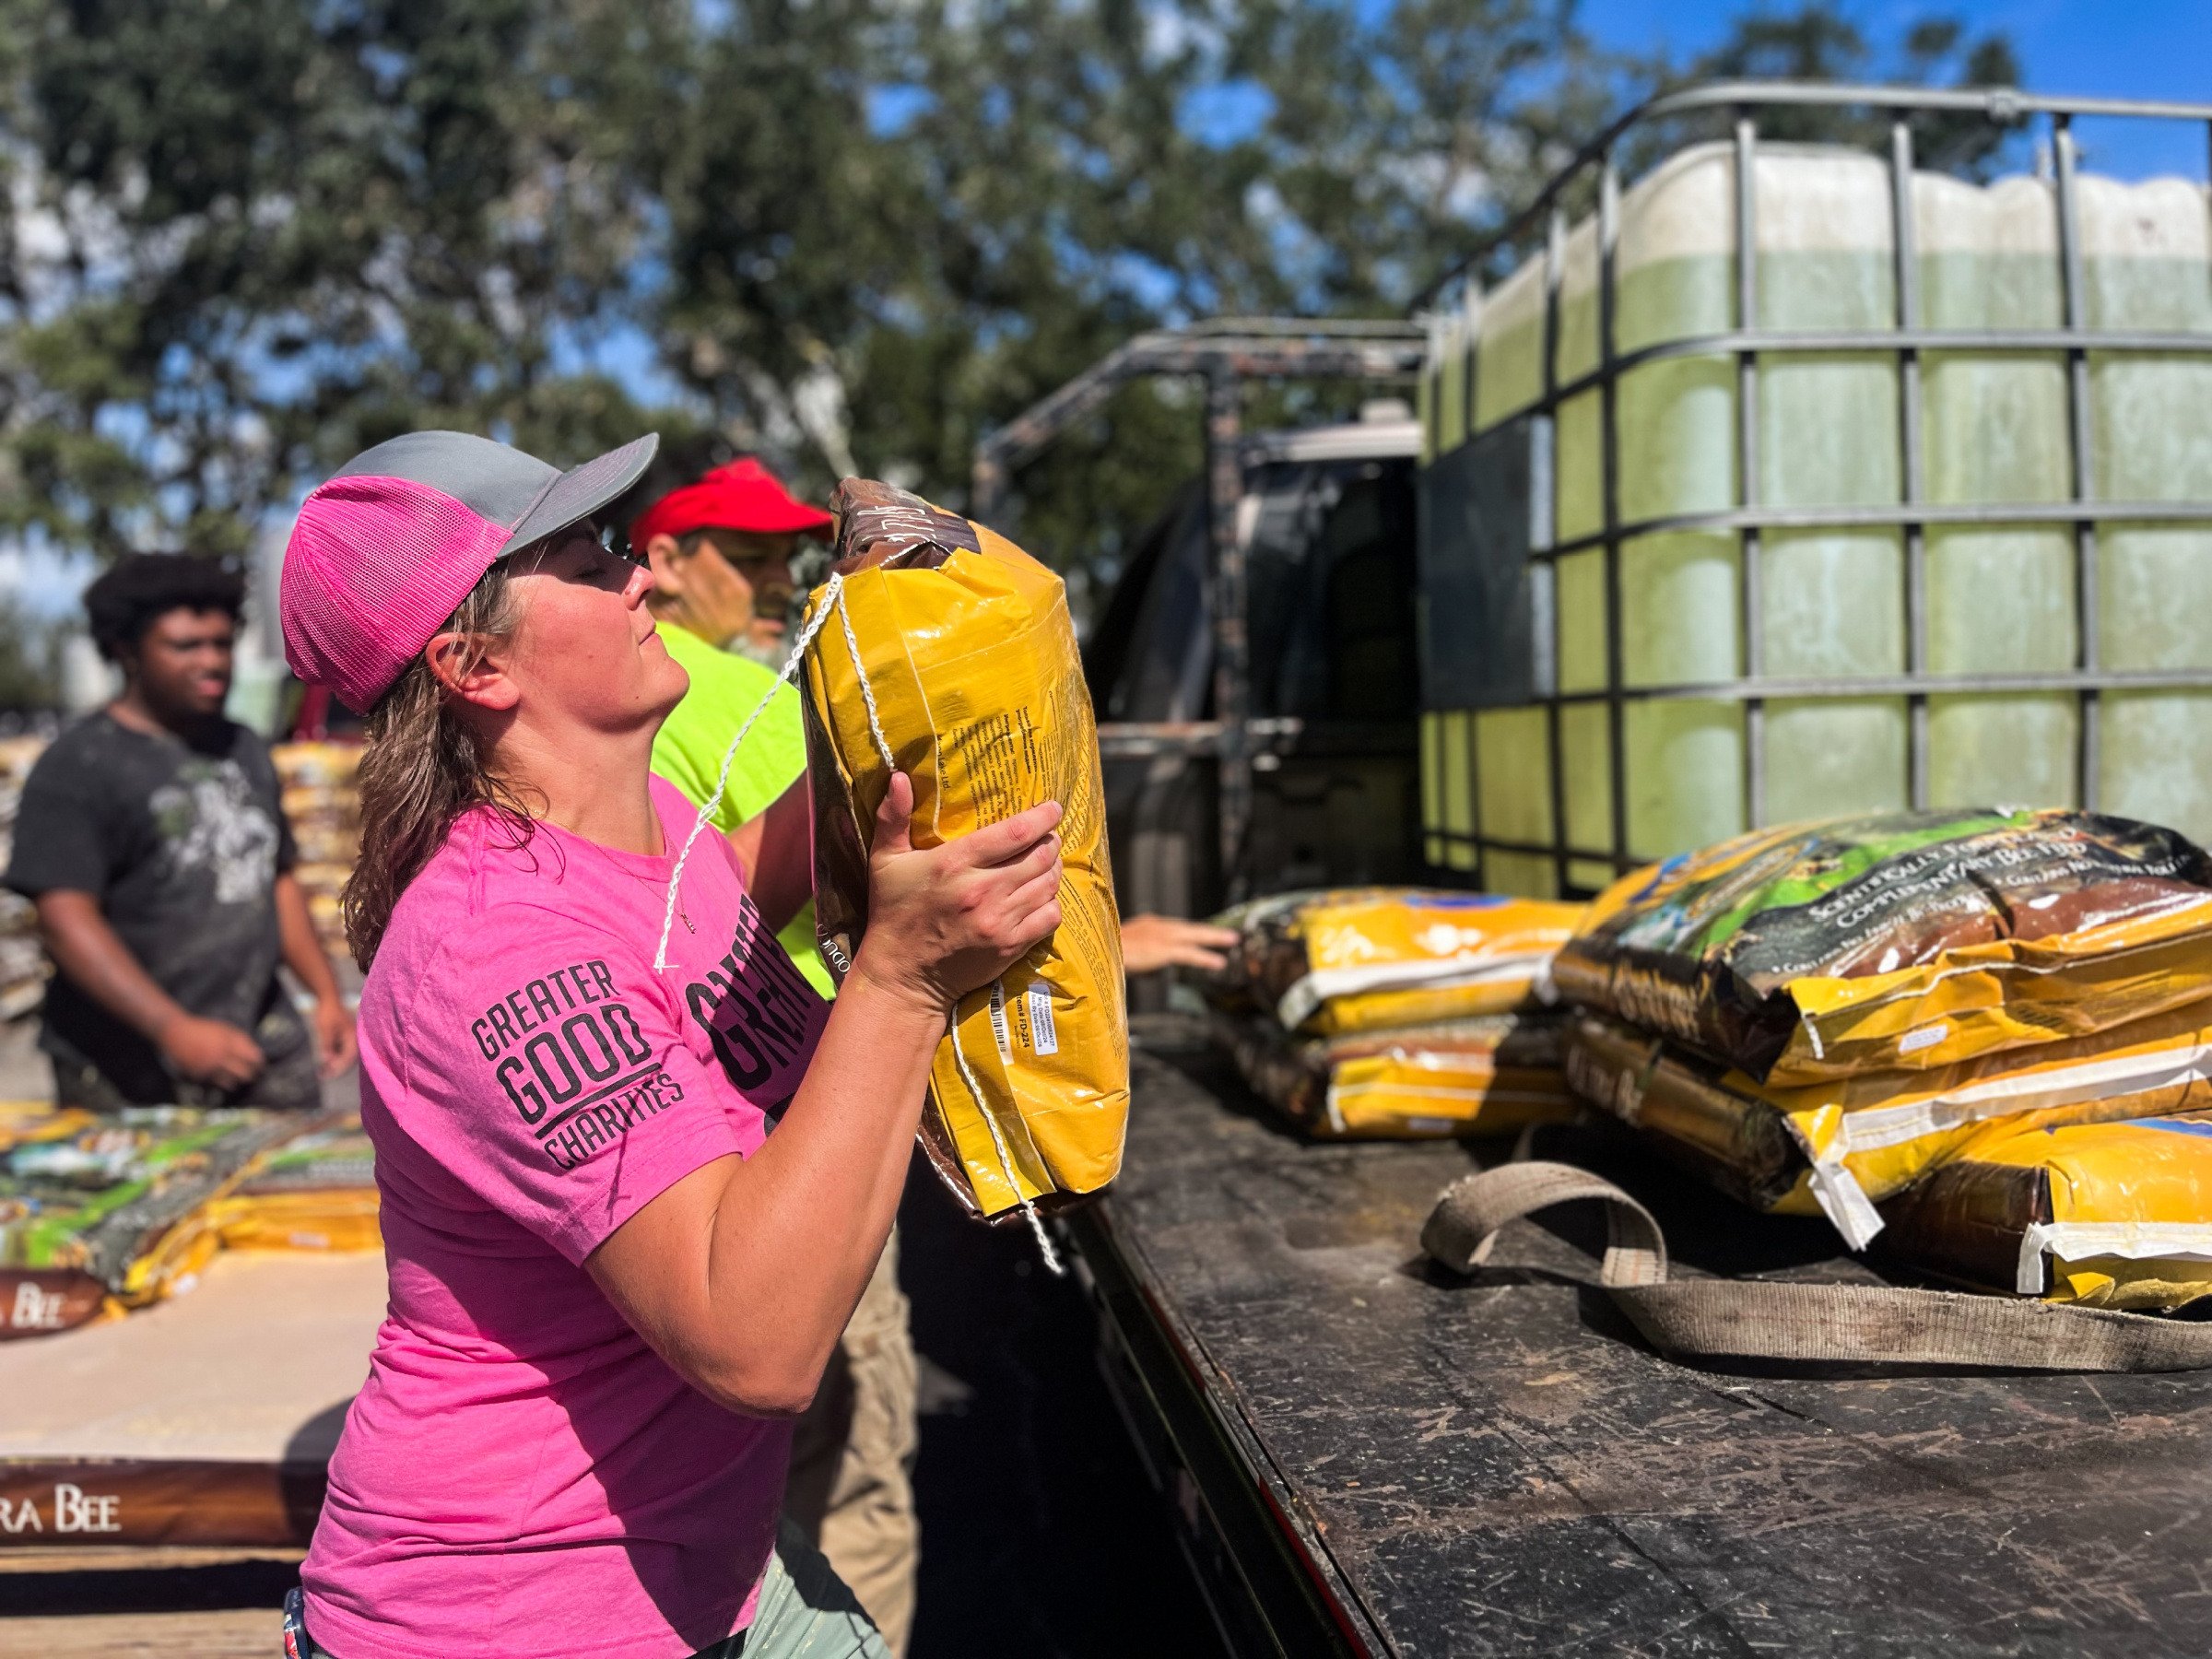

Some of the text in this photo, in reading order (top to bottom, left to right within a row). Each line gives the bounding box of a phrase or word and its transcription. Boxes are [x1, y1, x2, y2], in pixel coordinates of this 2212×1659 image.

[472, 959, 621, 1062] GREATER
[1018, 1018, 1030, 1048] FD-224
[495, 1003, 653, 1125] GOOD
[543, 1072, 686, 1171] CHARITIES
